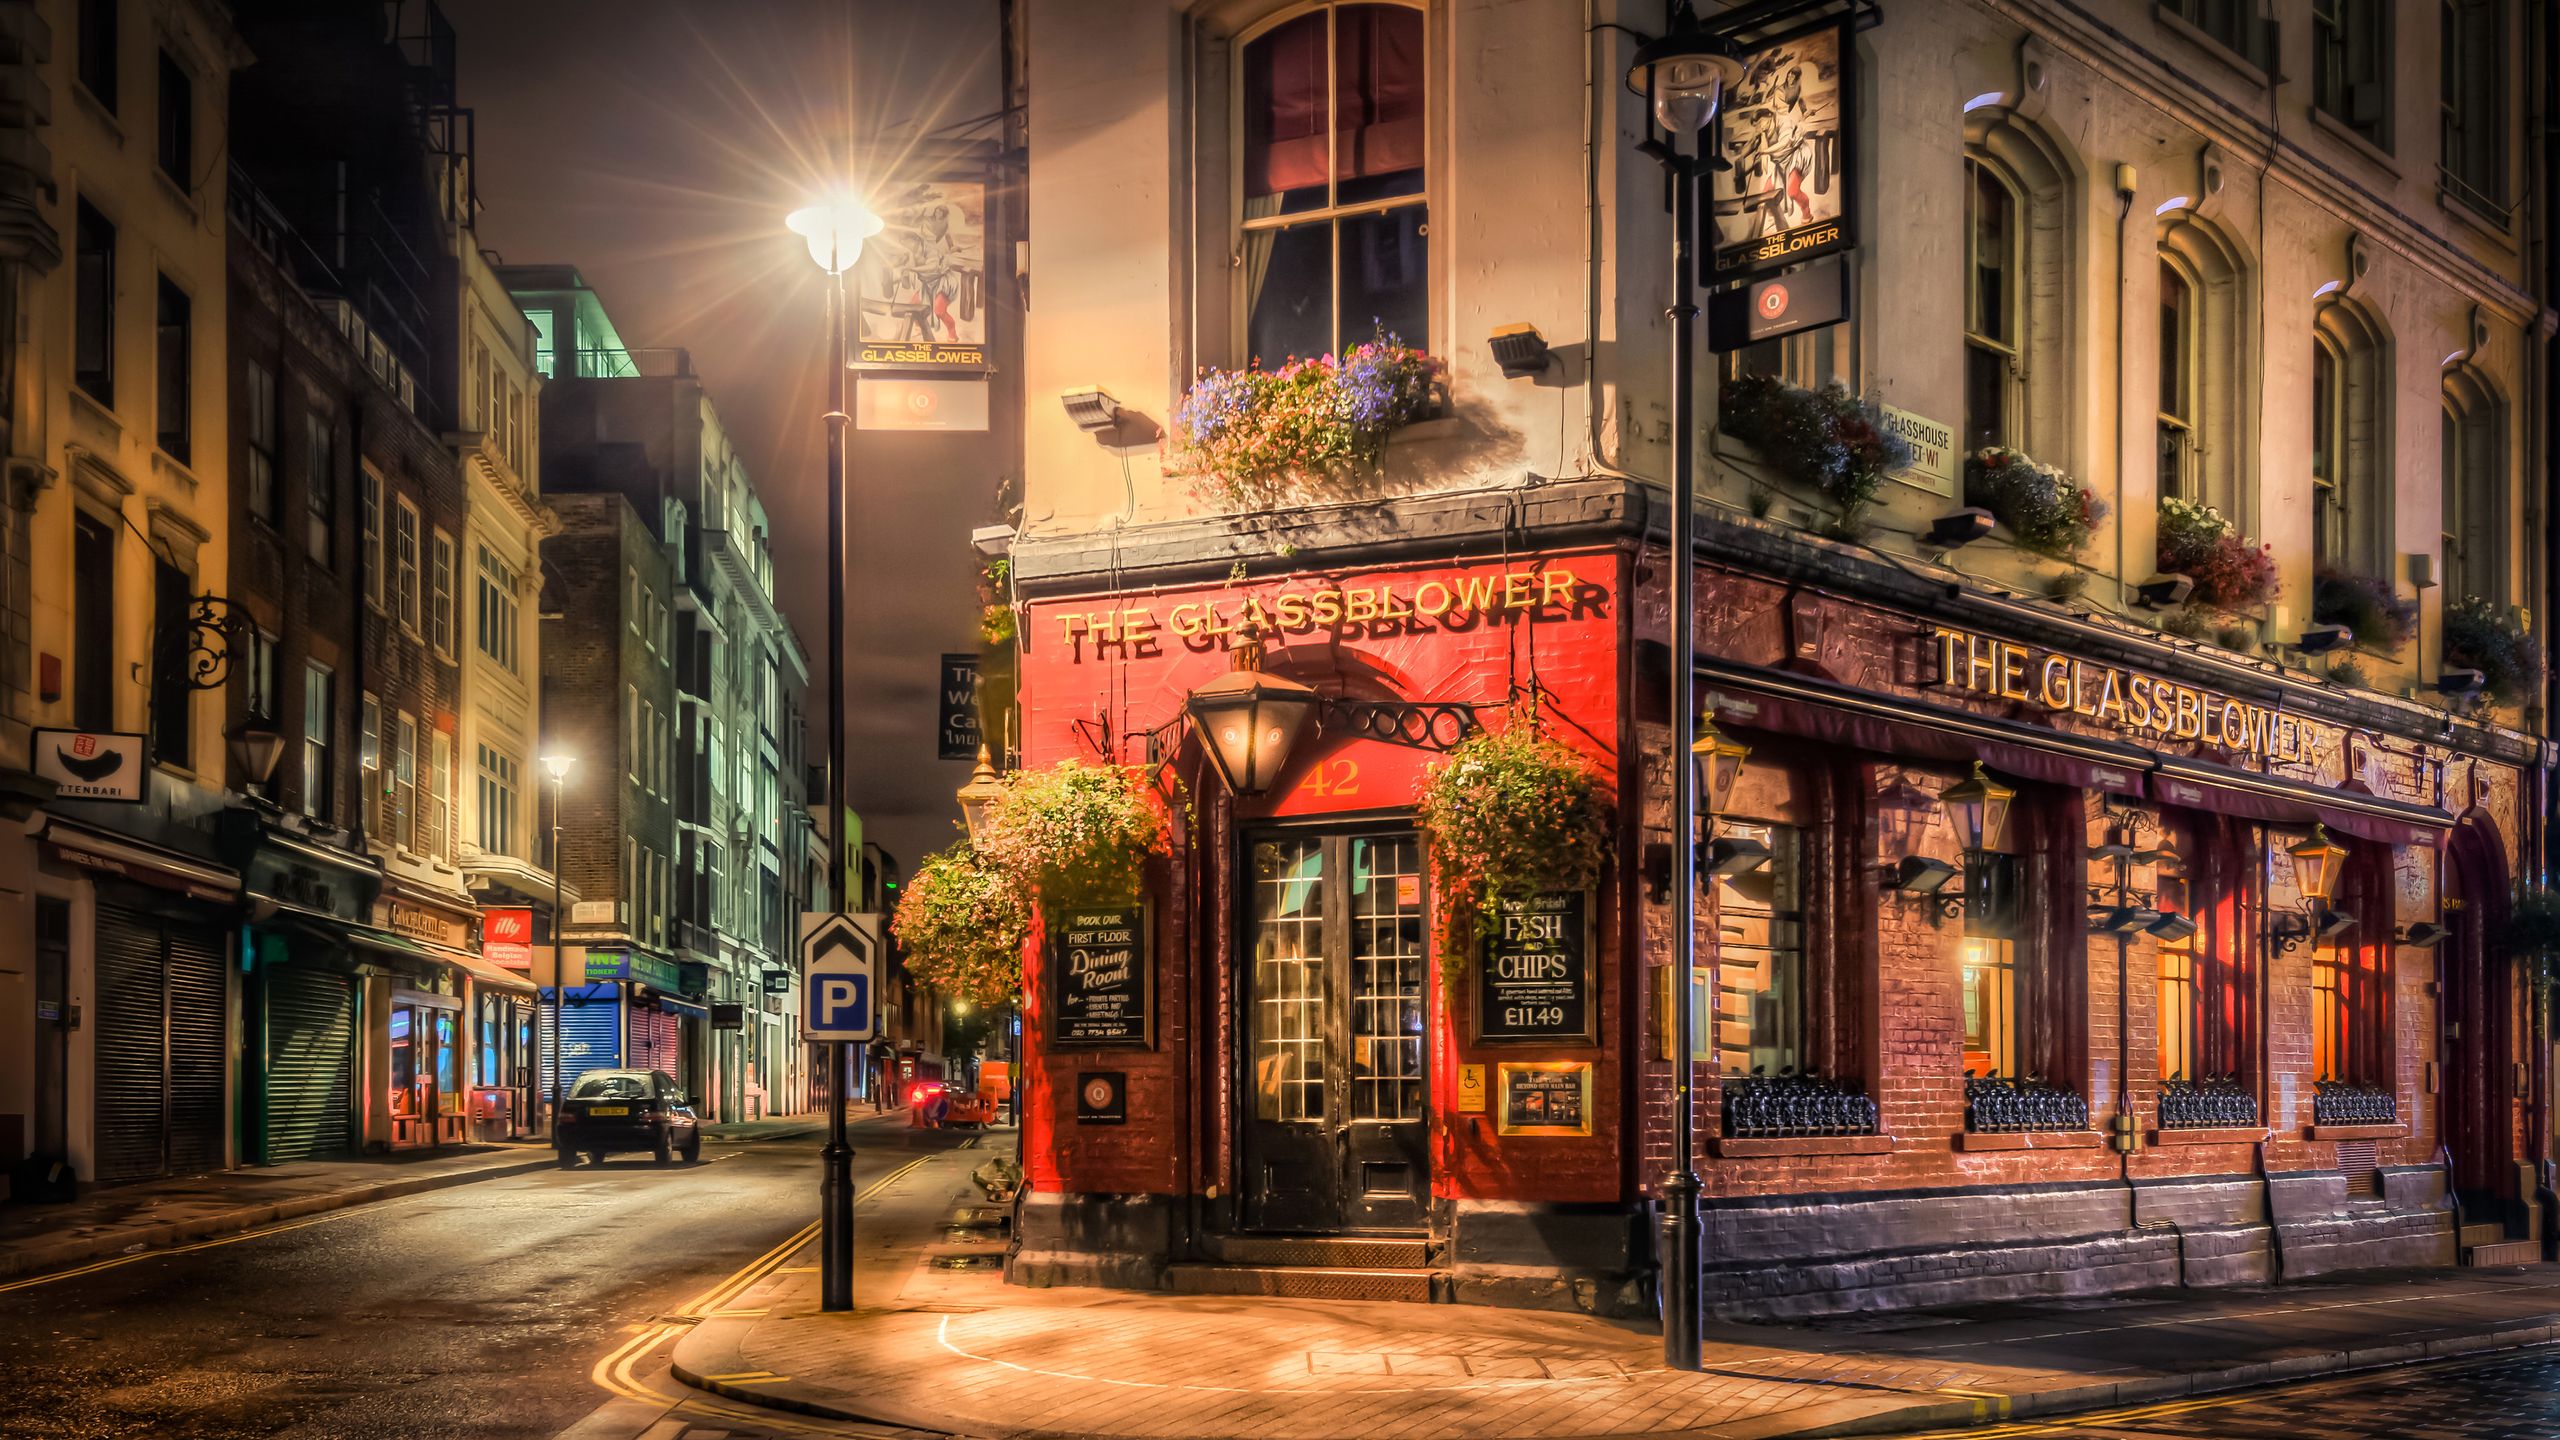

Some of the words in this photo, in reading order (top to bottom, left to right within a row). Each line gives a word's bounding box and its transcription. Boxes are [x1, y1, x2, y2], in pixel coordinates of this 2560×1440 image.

[1715, 227, 1839, 272] GLASSBLOWER
[1765, 233, 1786, 245] THE
[861, 350, 983, 364] GLASSBLOWER
[912, 343, 933, 352] THE
[1888, 412, 1949, 450] GLASSHOUSE
[1056, 607, 1151, 646] THE
[1169, 569, 1577, 637] GLASSBLOWER
[1935, 626, 2029, 701] THE
[2041, 653, 2321, 767] GLASSBLOWER
[1299, 759, 1360, 798] 42
[495, 917, 521, 938] illy
[1077, 915, 1101, 926] BOOK
[1103, 915, 1122, 925] OUR
[1504, 915, 1563, 940] FISH
[1068, 933, 1094, 944] FIRST
[1098, 931, 1132, 943] FLOOR
[1069, 949, 1133, 976] Dining
[1498, 954, 1567, 979] CHIPS
[1083, 966, 1131, 989] Room
[822, 980, 857, 1025] P
[1505, 1007, 1564, 1026] £11.49
